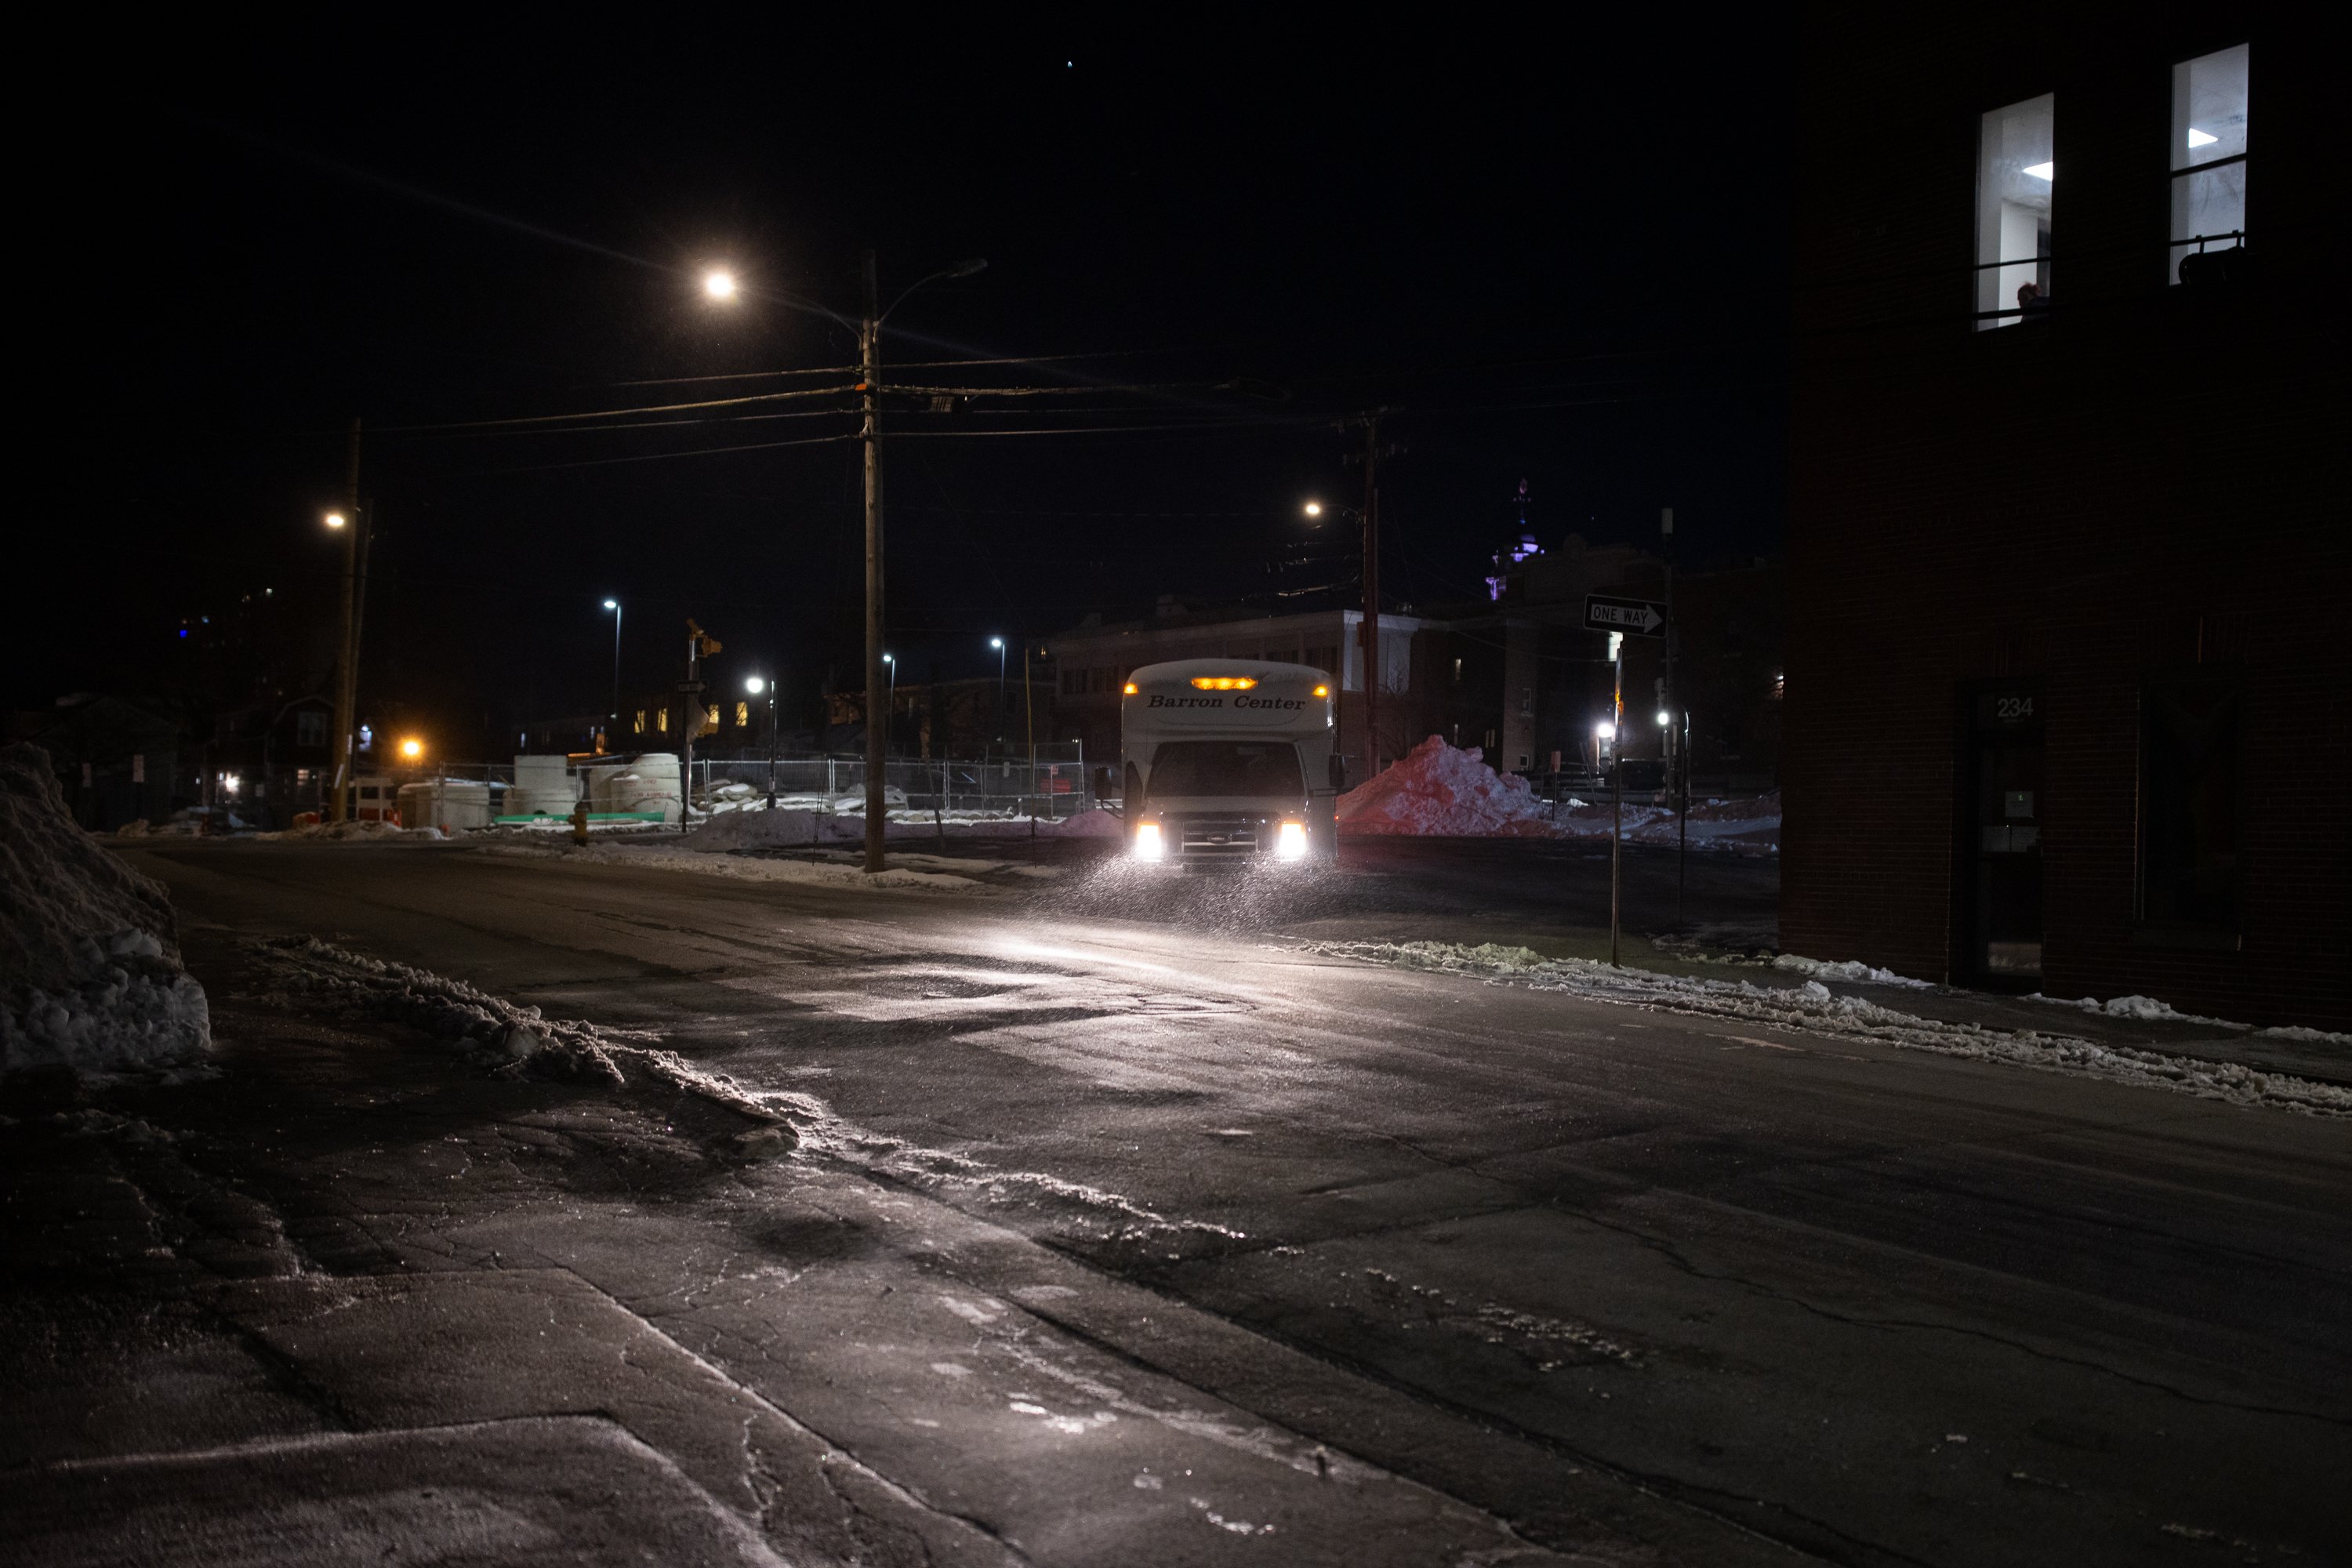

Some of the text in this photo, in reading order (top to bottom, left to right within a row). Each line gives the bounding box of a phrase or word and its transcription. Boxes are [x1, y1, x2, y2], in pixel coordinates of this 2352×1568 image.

[1594, 606, 1648, 624] ONE WAY
[1147, 695, 1306, 710] Barron Center
[1997, 696, 2034, 718] 234
